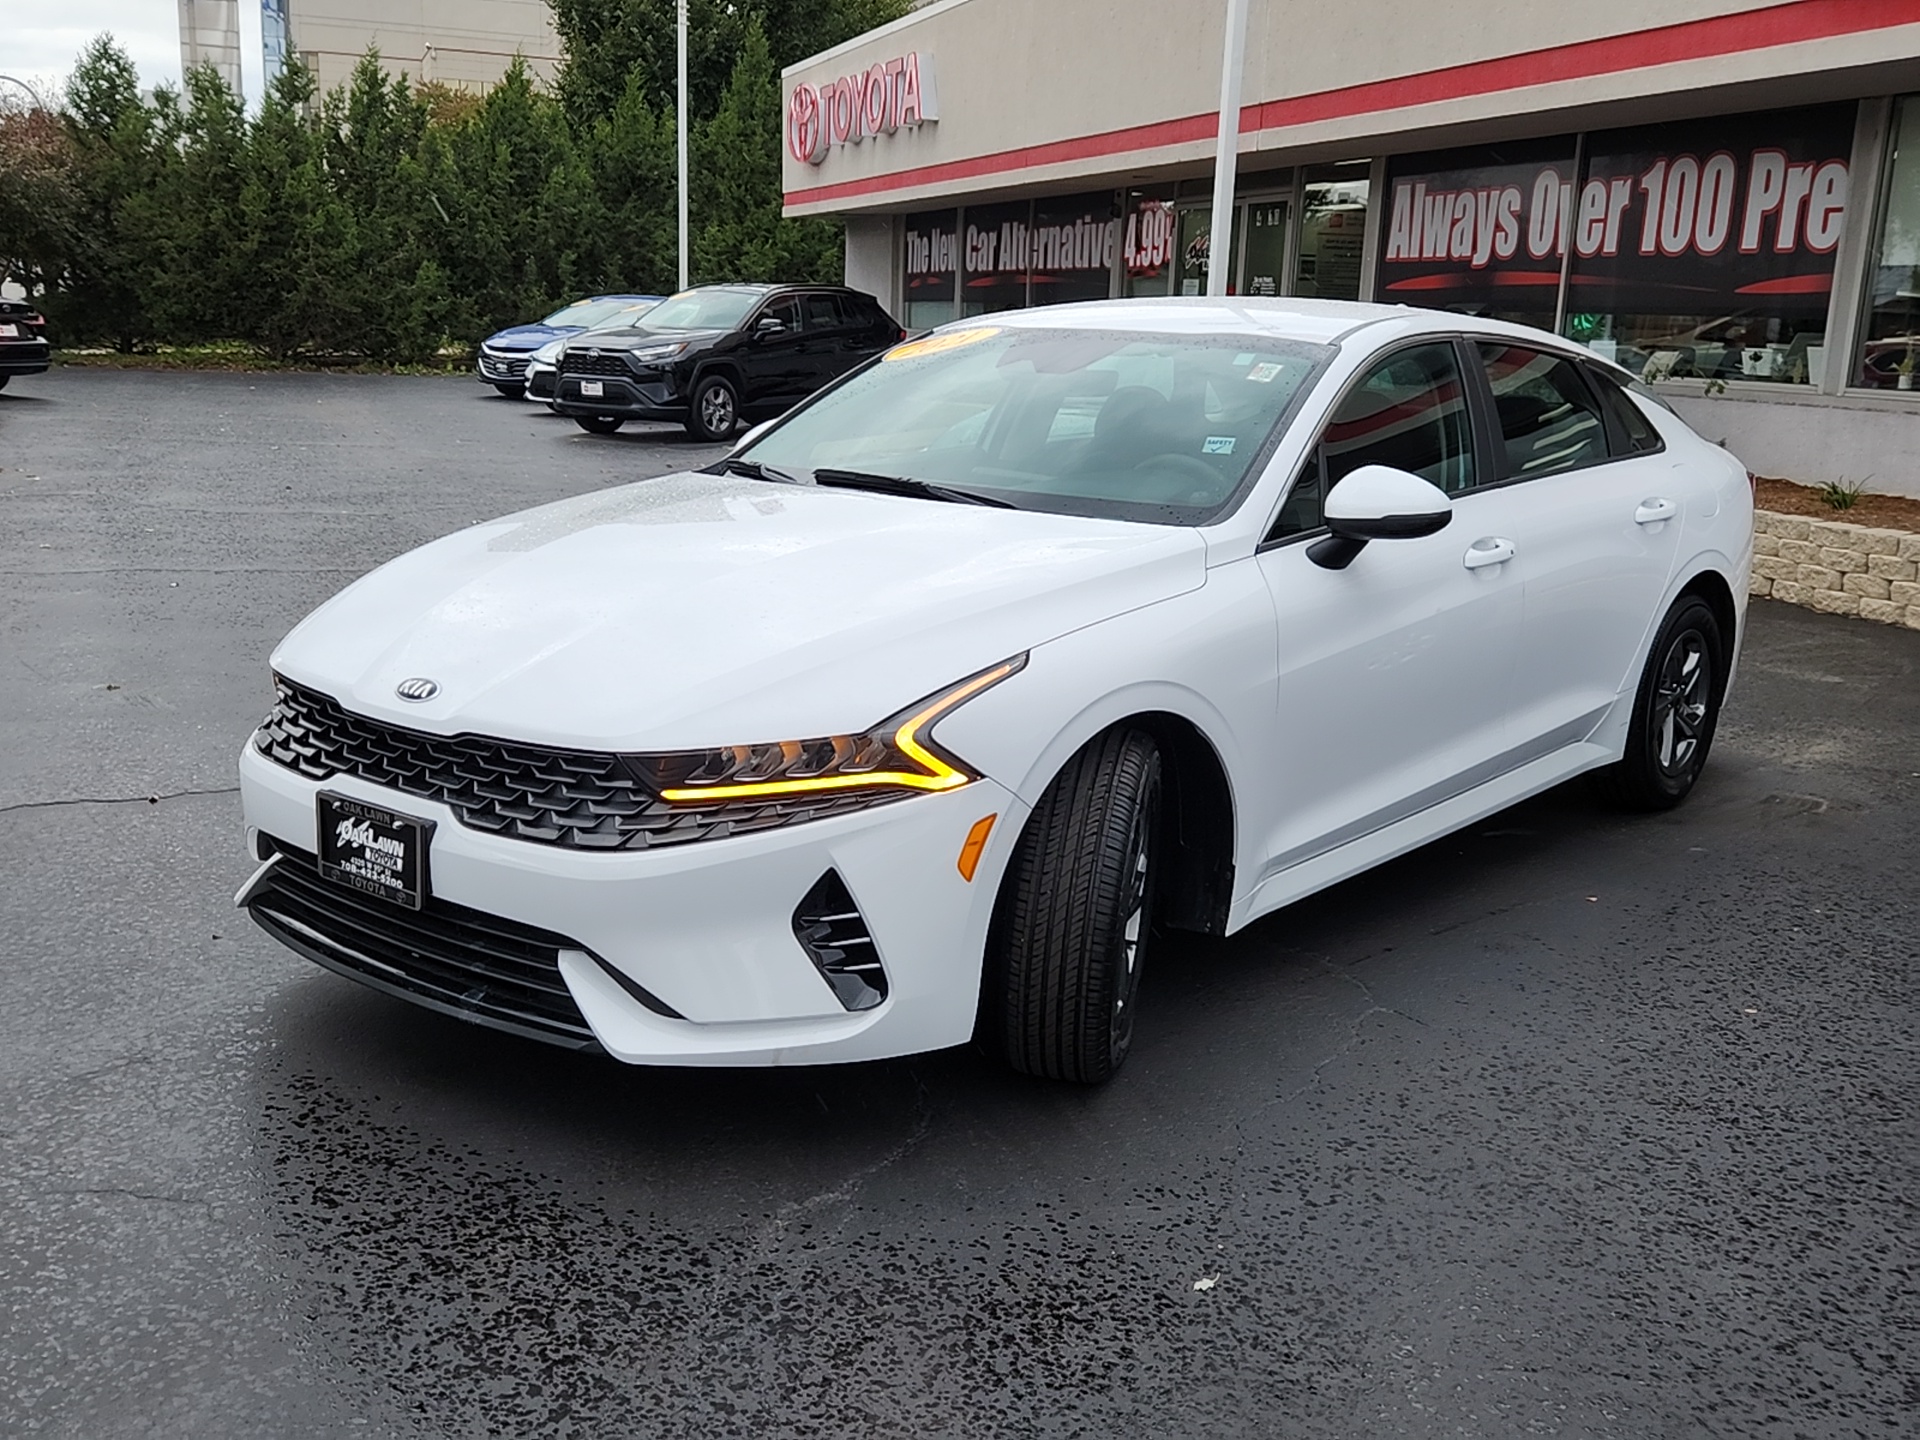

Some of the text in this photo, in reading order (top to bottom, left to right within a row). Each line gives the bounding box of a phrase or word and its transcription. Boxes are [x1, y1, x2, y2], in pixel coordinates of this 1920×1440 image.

[820, 52, 922, 147] TOYOTA
[1386, 150, 1848, 268] Always Over 100 Pre
[907, 215, 1115, 273] The New Car Alternative
[399, 680, 433, 698] KIA
[343, 801, 391, 824] OAK LAWN
[369, 849, 400, 871] TOYOTA
[349, 874, 386, 897] TOYOTA
